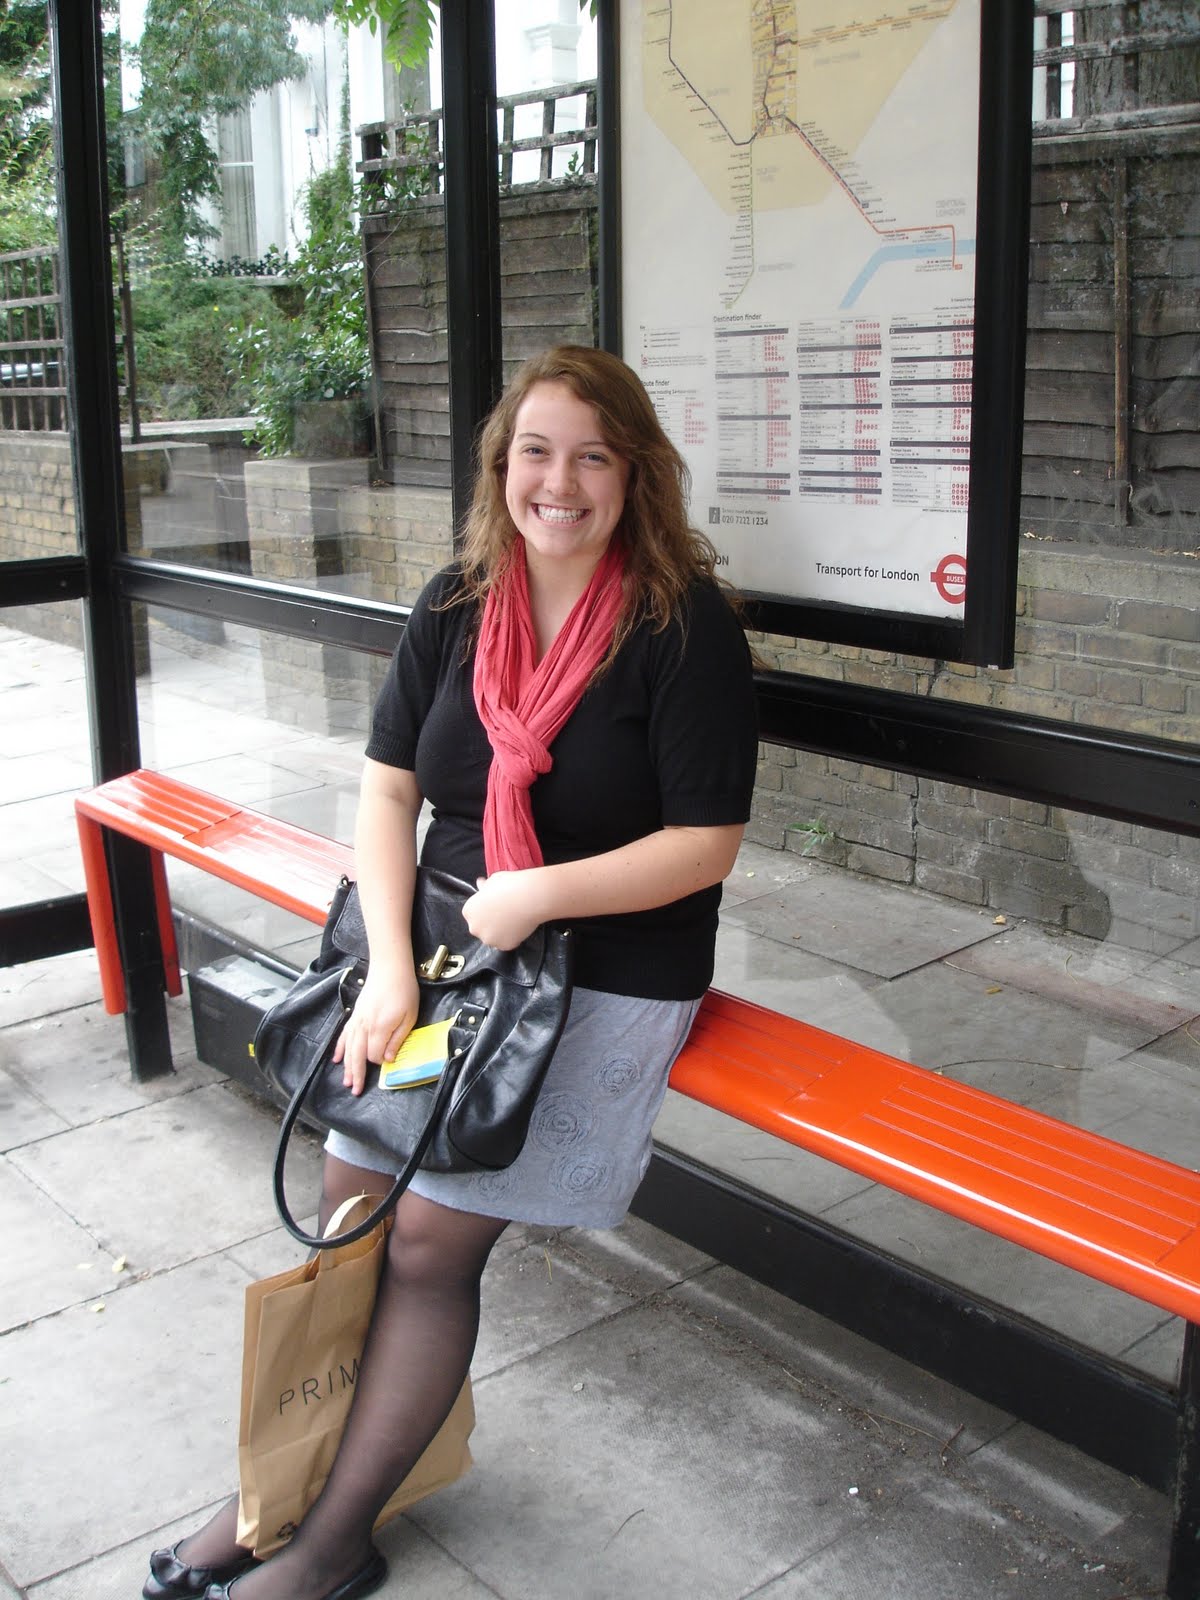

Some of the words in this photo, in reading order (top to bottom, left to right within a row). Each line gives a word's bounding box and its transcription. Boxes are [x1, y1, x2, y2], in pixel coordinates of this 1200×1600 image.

[713, 315, 744, 323] Destination
[722, 515, 734, 524] 020
[736, 515, 750, 525] 7222
[752, 516, 769, 525] 1234
[816, 563, 862, 578] Transport
[864, 566, 879, 578] for
[881, 568, 920, 582] London
[946, 575, 964, 583] BUSES
